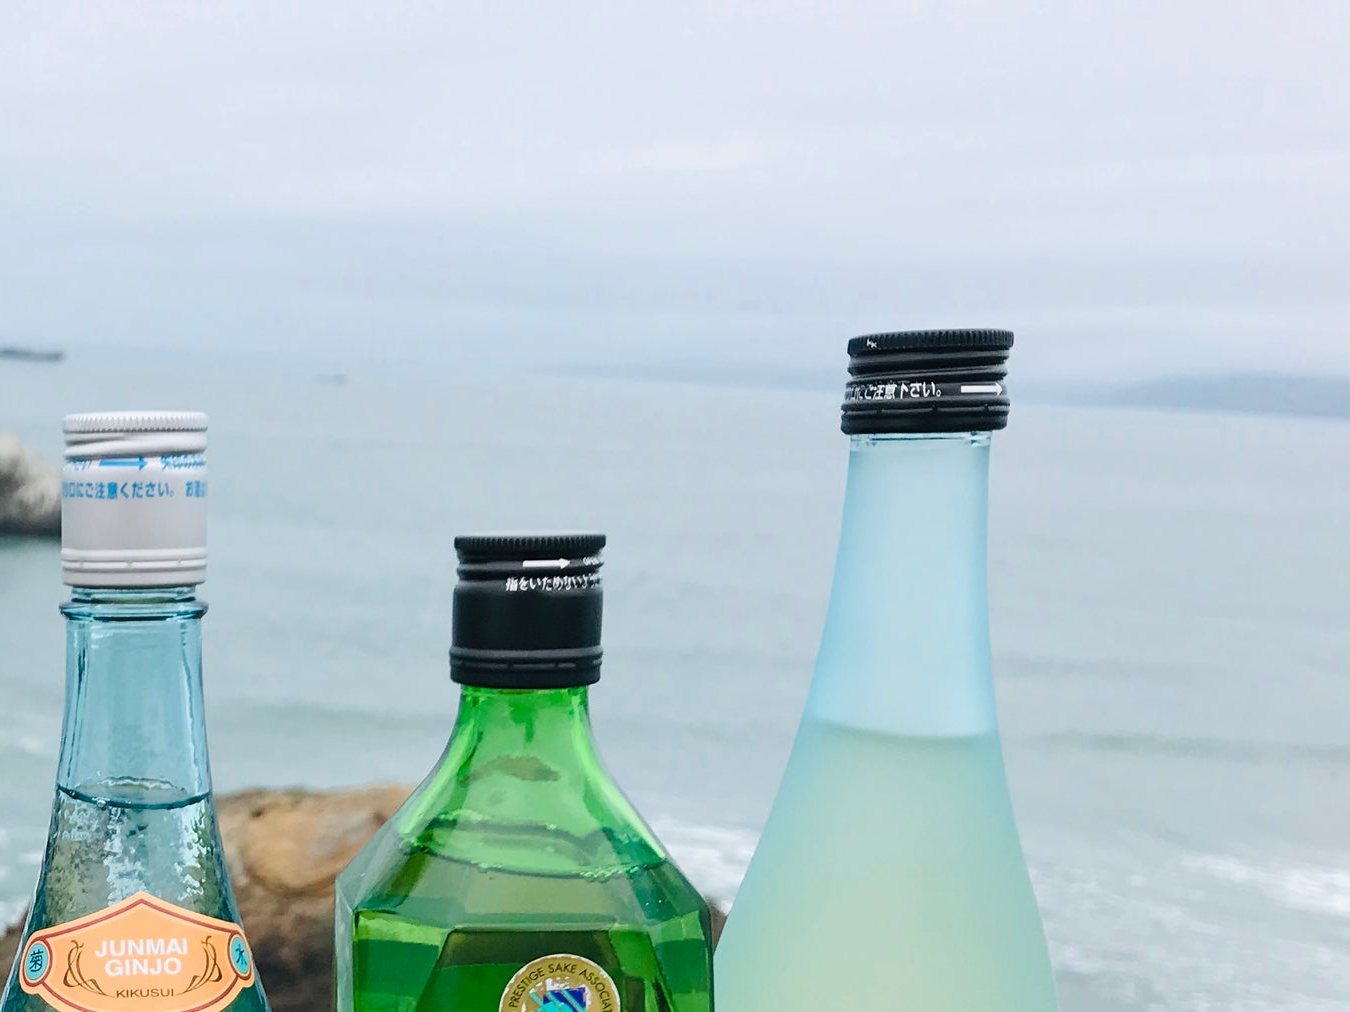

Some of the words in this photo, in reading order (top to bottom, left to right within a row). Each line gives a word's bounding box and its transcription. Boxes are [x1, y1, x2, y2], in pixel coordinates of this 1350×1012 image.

[94, 938, 188, 958] JUNMAI
[28, 949, 44, 973] 菊
[105, 957, 182, 977] GINJO
[116, 988, 174, 999] KIKUSUI
[508, 967, 545, 1008] PRESTIGE
[548, 963, 578, 974] SAKE
